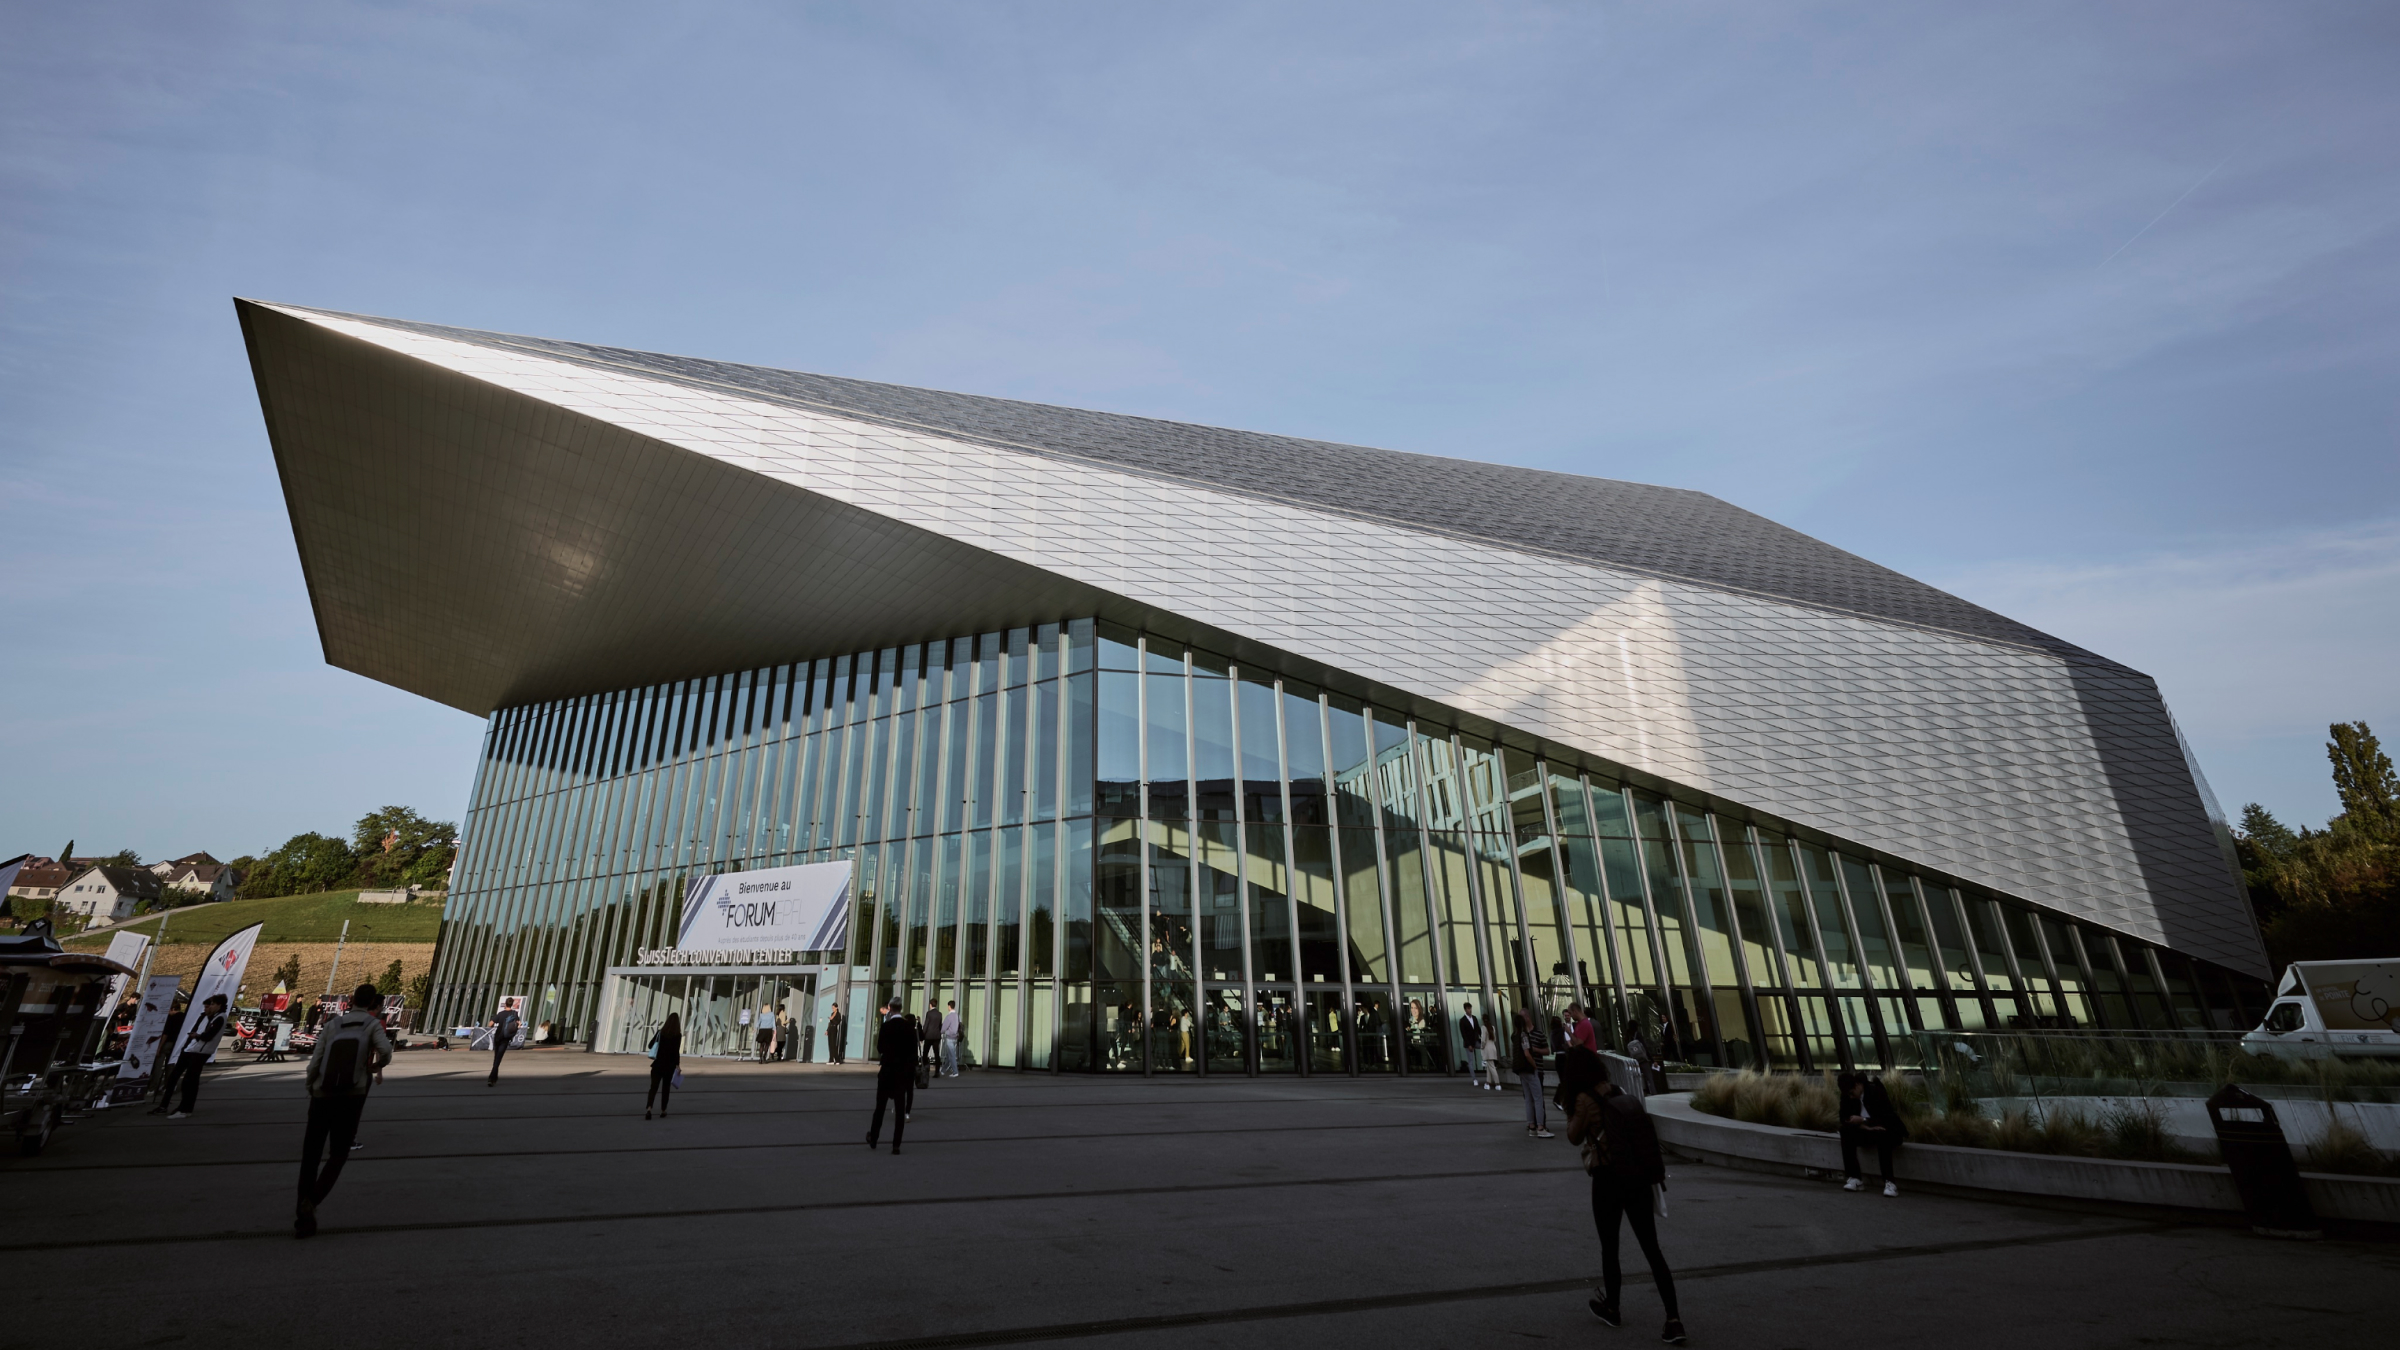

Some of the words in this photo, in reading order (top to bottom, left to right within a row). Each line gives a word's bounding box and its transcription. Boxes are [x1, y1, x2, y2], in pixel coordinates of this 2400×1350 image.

[738, 881, 779, 895] Bienvenue
[780, 880, 791, 891] au
[689, 948, 752, 964] CONVENTION
[752, 947, 793, 963] CENTER
[2324, 990, 2351, 1000] POINTE
